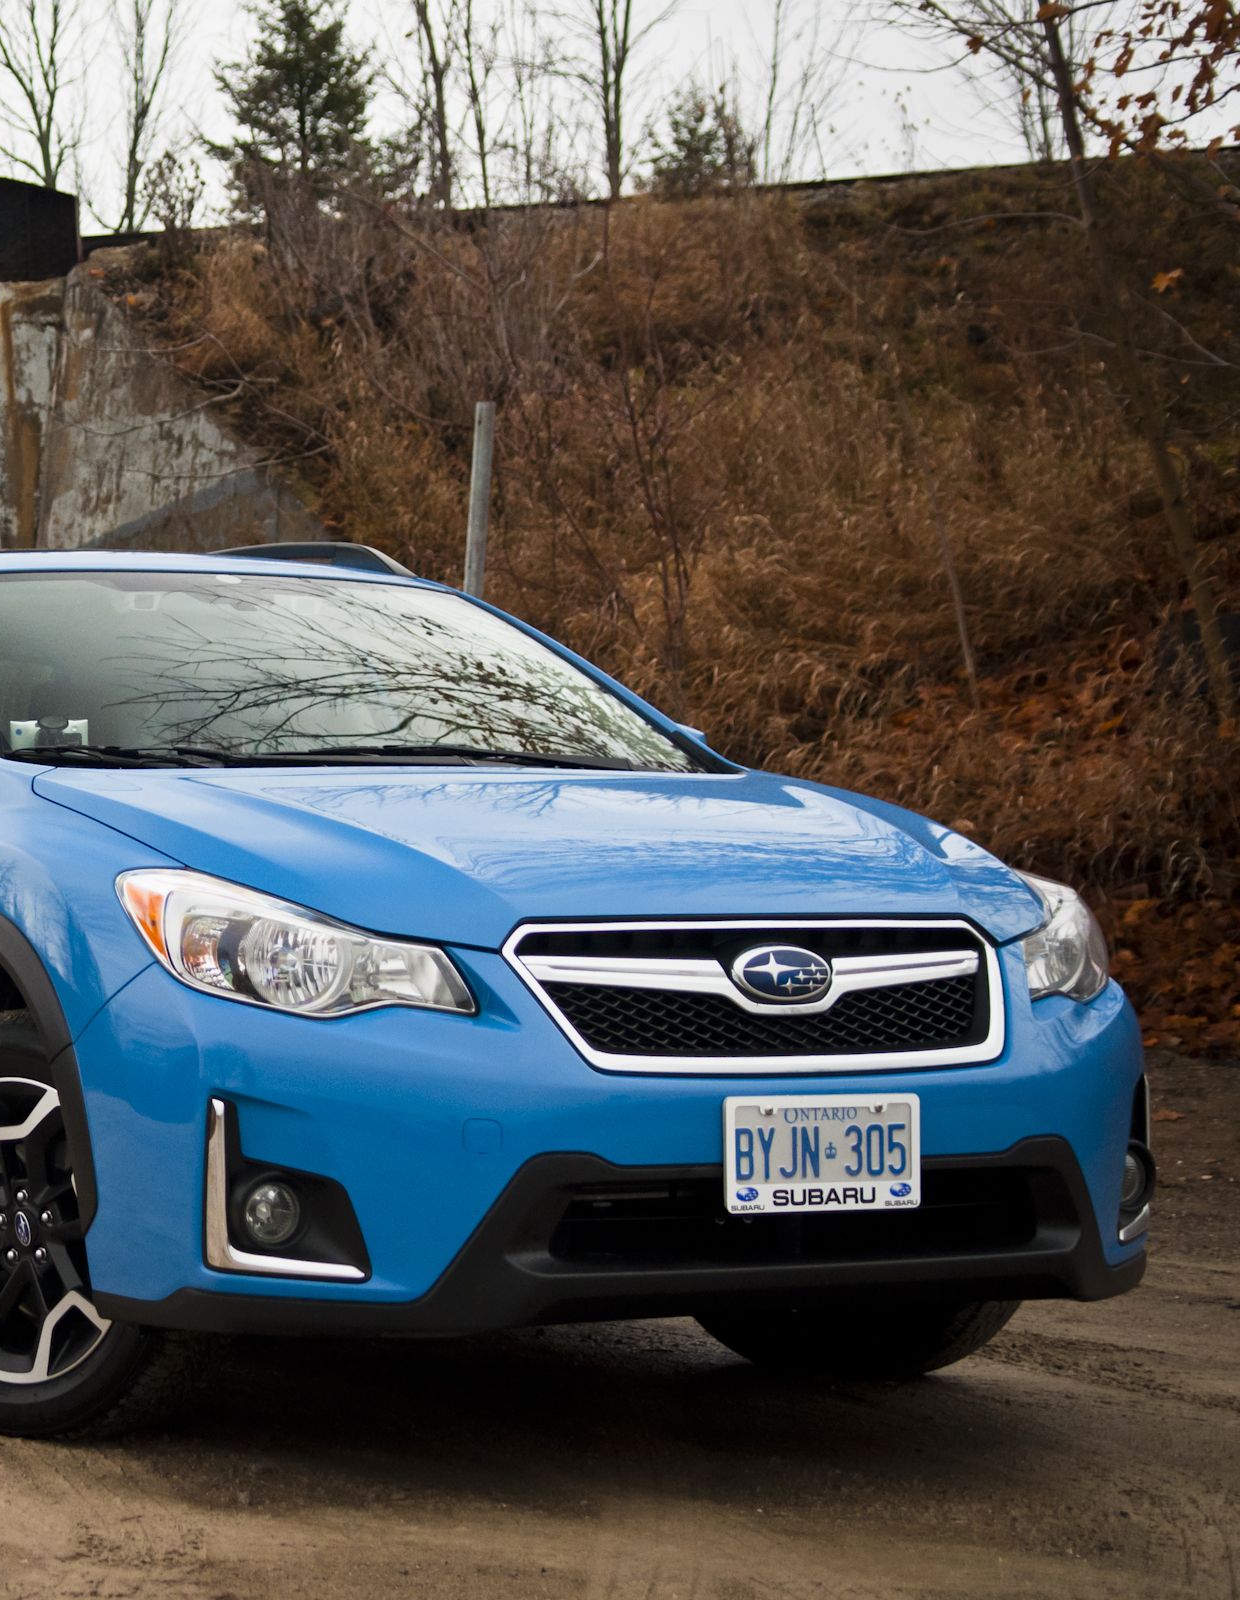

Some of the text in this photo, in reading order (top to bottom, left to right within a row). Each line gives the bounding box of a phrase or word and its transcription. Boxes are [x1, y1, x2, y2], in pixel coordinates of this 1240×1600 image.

[784, 1107, 857, 1124] ONTARIO
[735, 1123, 907, 1182] BYJN 305
[772, 1187, 876, 1206] SUBARU
[884, 1199, 918, 1207] SUBARU
[731, 1204, 765, 1212] SUBARU
